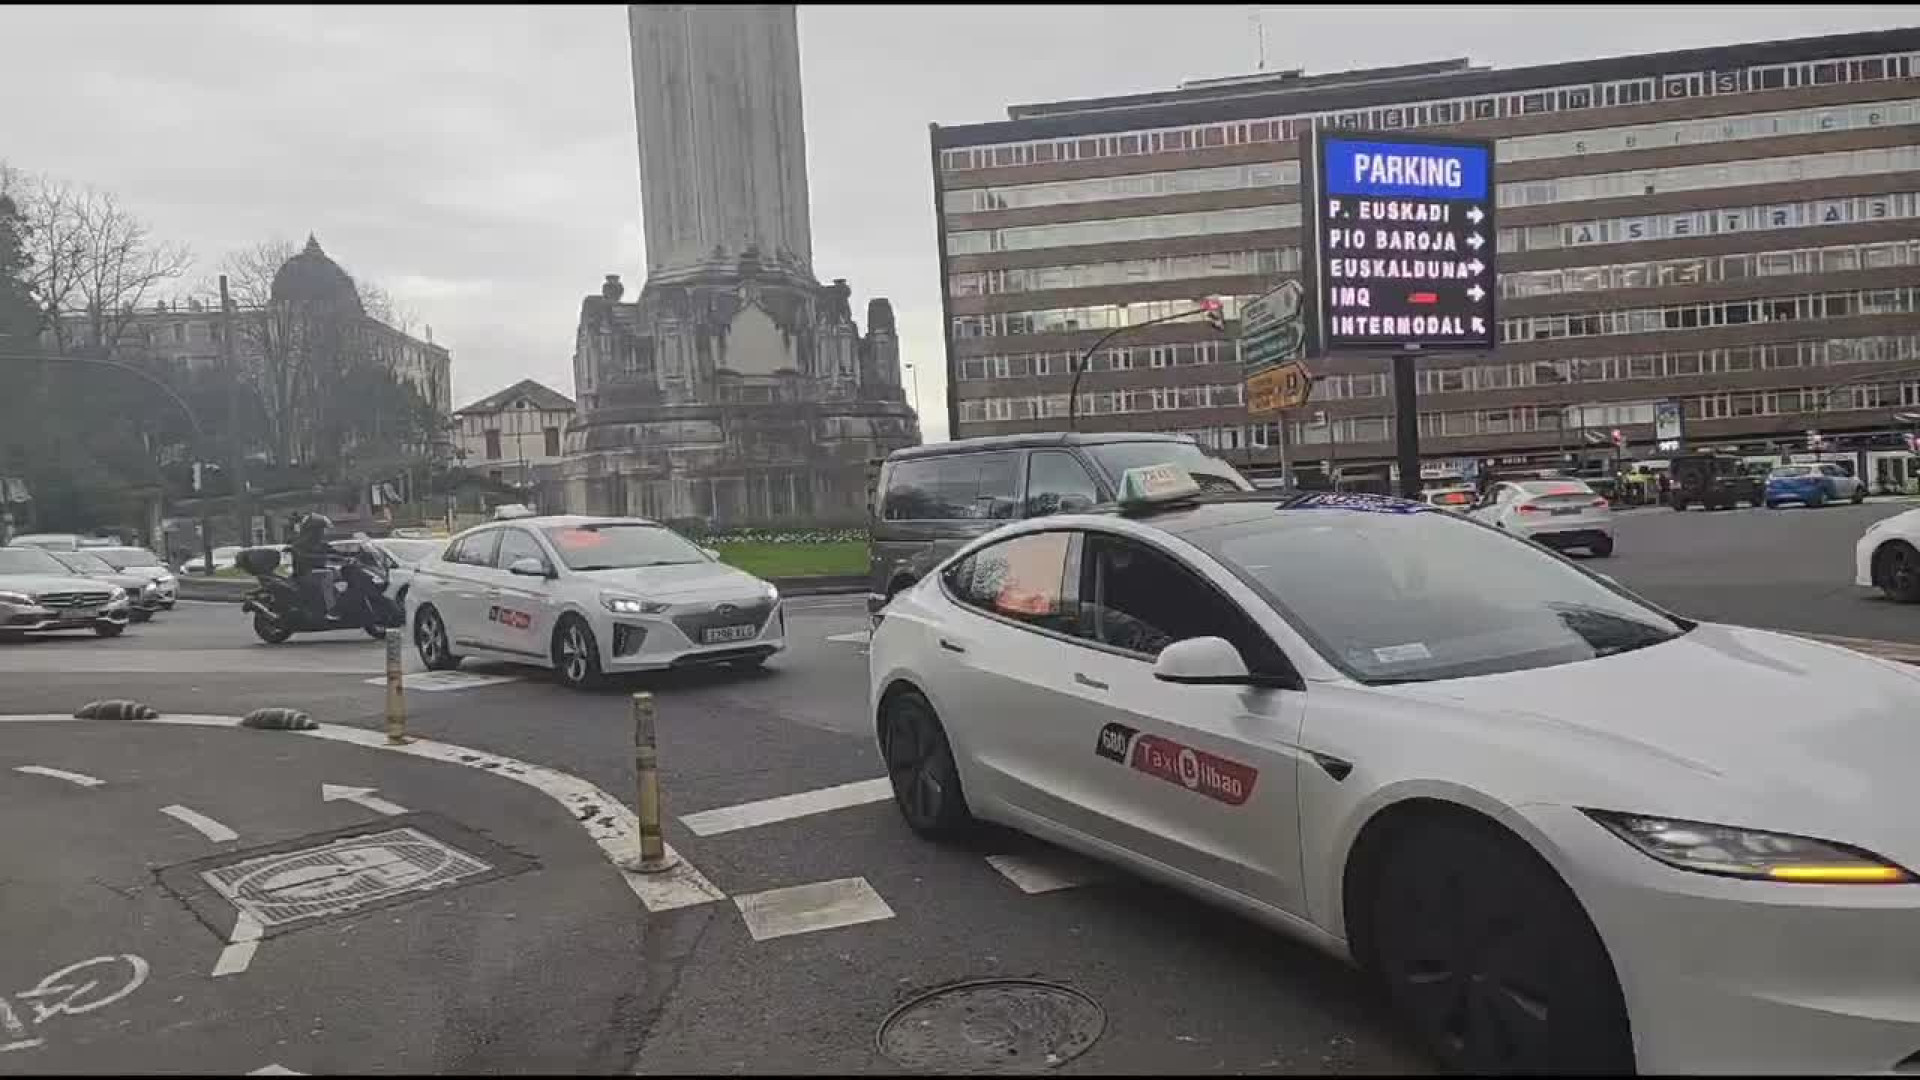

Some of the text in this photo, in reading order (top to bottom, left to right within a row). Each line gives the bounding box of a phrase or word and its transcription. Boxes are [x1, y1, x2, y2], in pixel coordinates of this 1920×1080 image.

[1354, 153, 1462, 188] PARKING
[1329, 199, 1450, 223] P. EUSKADI
[1329, 228, 1456, 251] PIO BAROJA
[1330, 258, 1468, 279] EUSKALDUNA
[1331, 287, 1371, 307] IMQ
[1331, 316, 1465, 335] INTERMODAL
